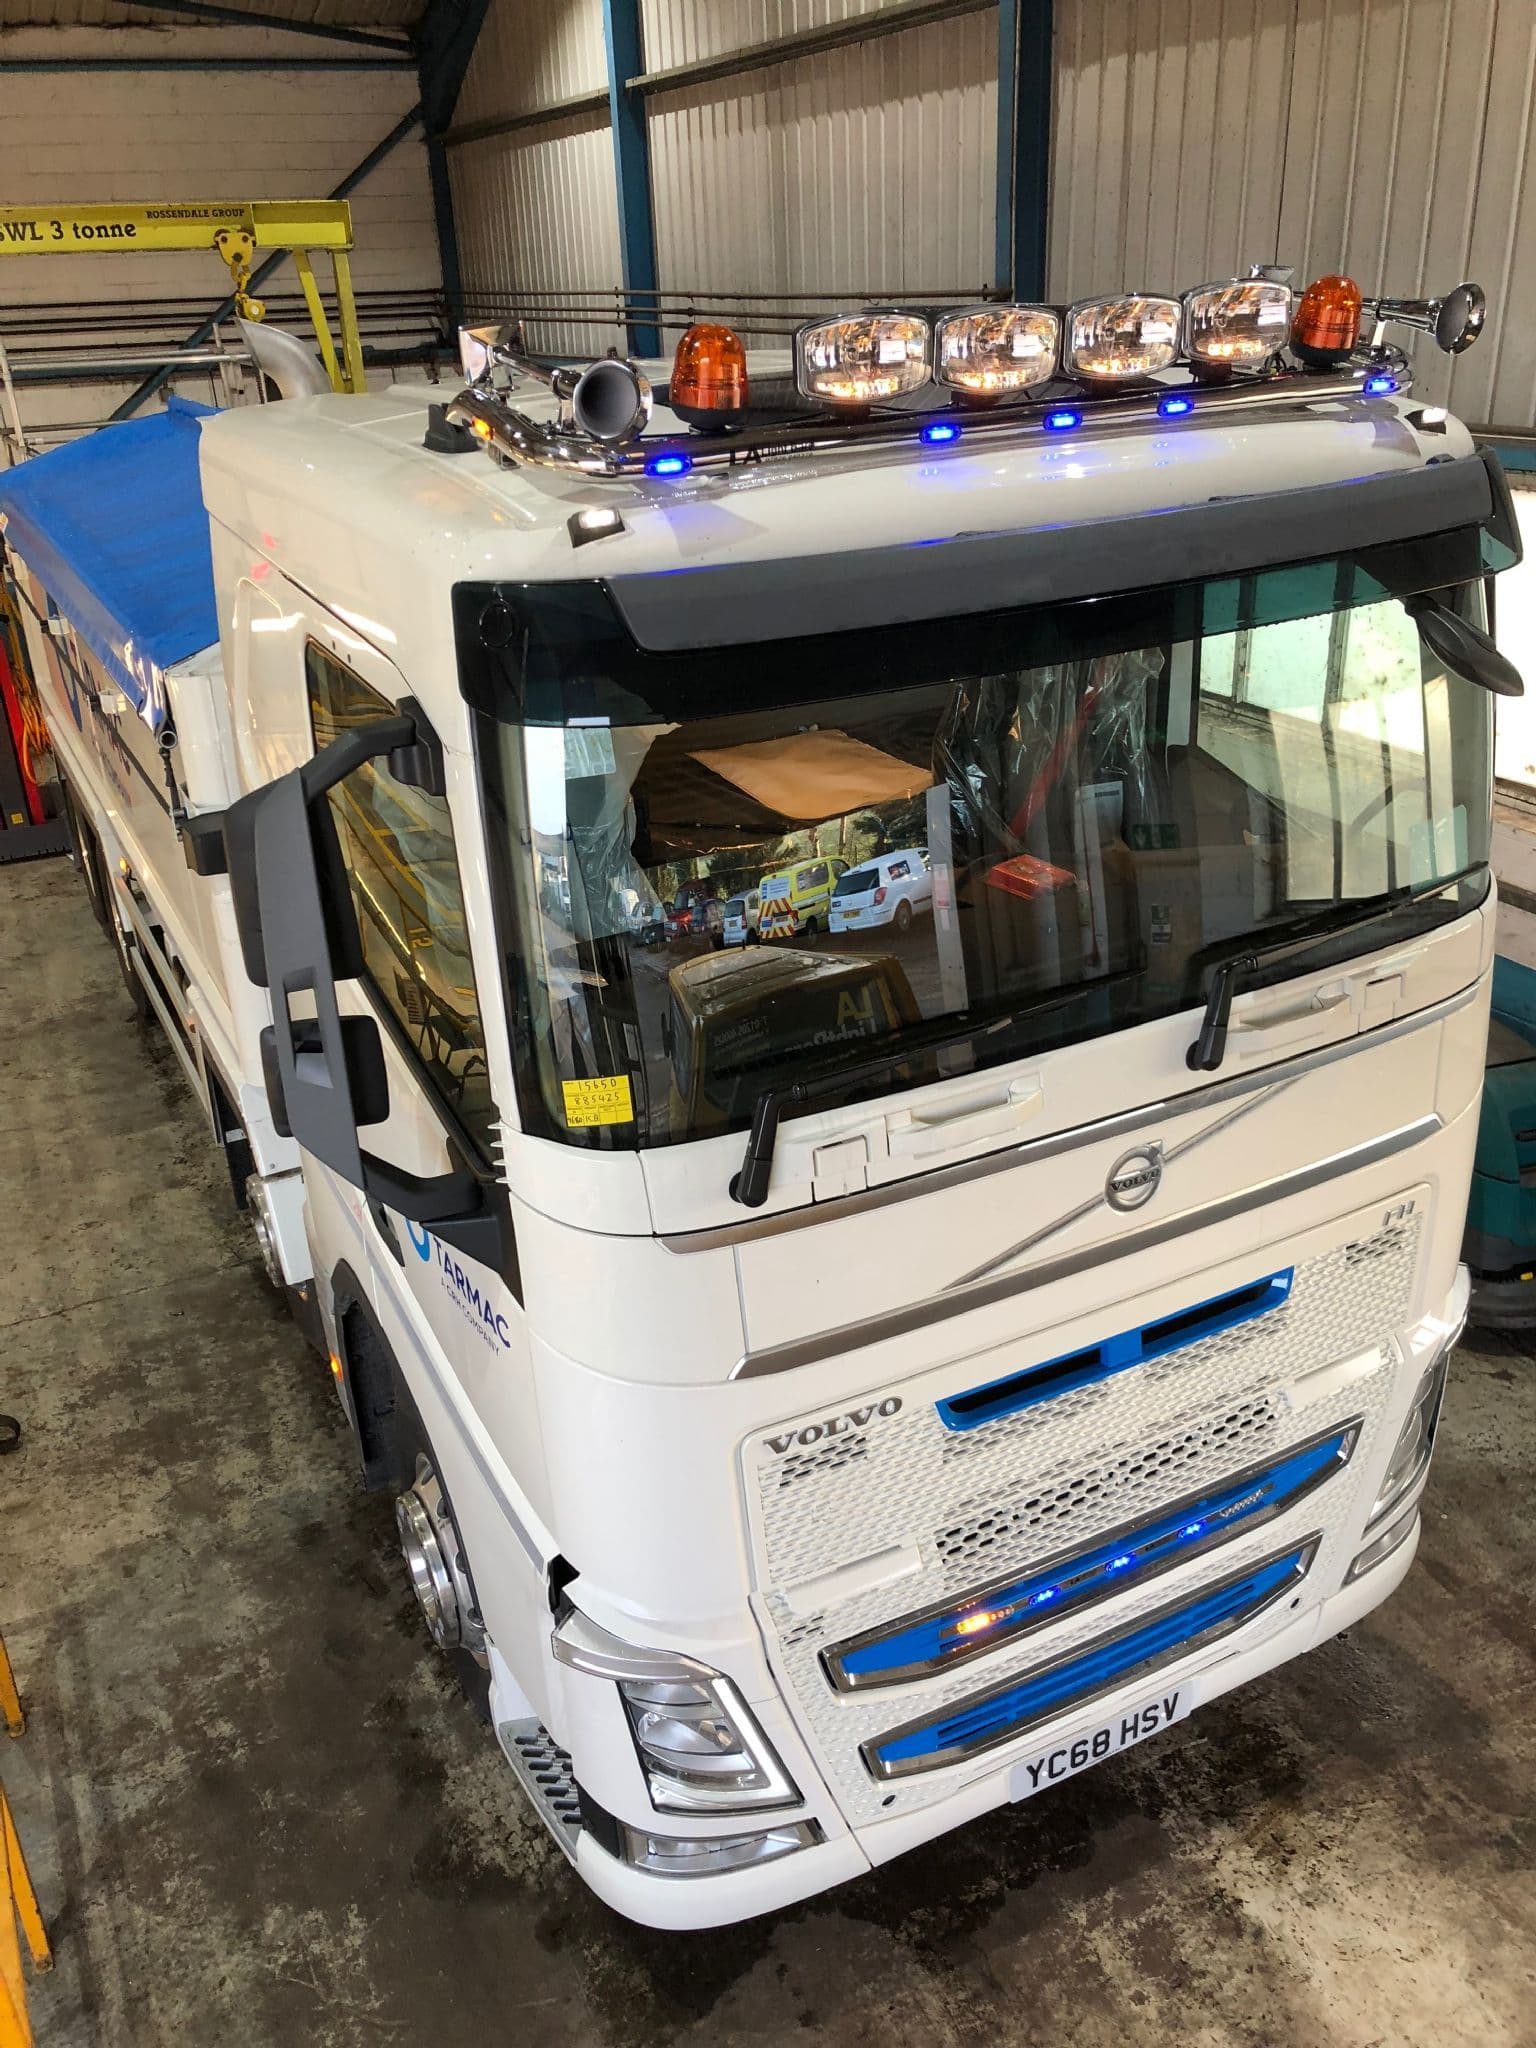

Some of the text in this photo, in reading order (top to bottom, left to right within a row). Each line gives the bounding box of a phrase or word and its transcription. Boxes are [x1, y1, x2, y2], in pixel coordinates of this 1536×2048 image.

[50, 220, 64, 240] 3
[73, 222, 136, 239] tonne
[146, 208, 245, 219] ROSSENDALE GROUP
[1110, 1167, 1160, 1191] VOLVO
[433, 1237, 511, 1348] TARMAC
[763, 1397, 903, 1454] VOLVO
[1026, 1691, 1179, 1788] YC68 HSV
